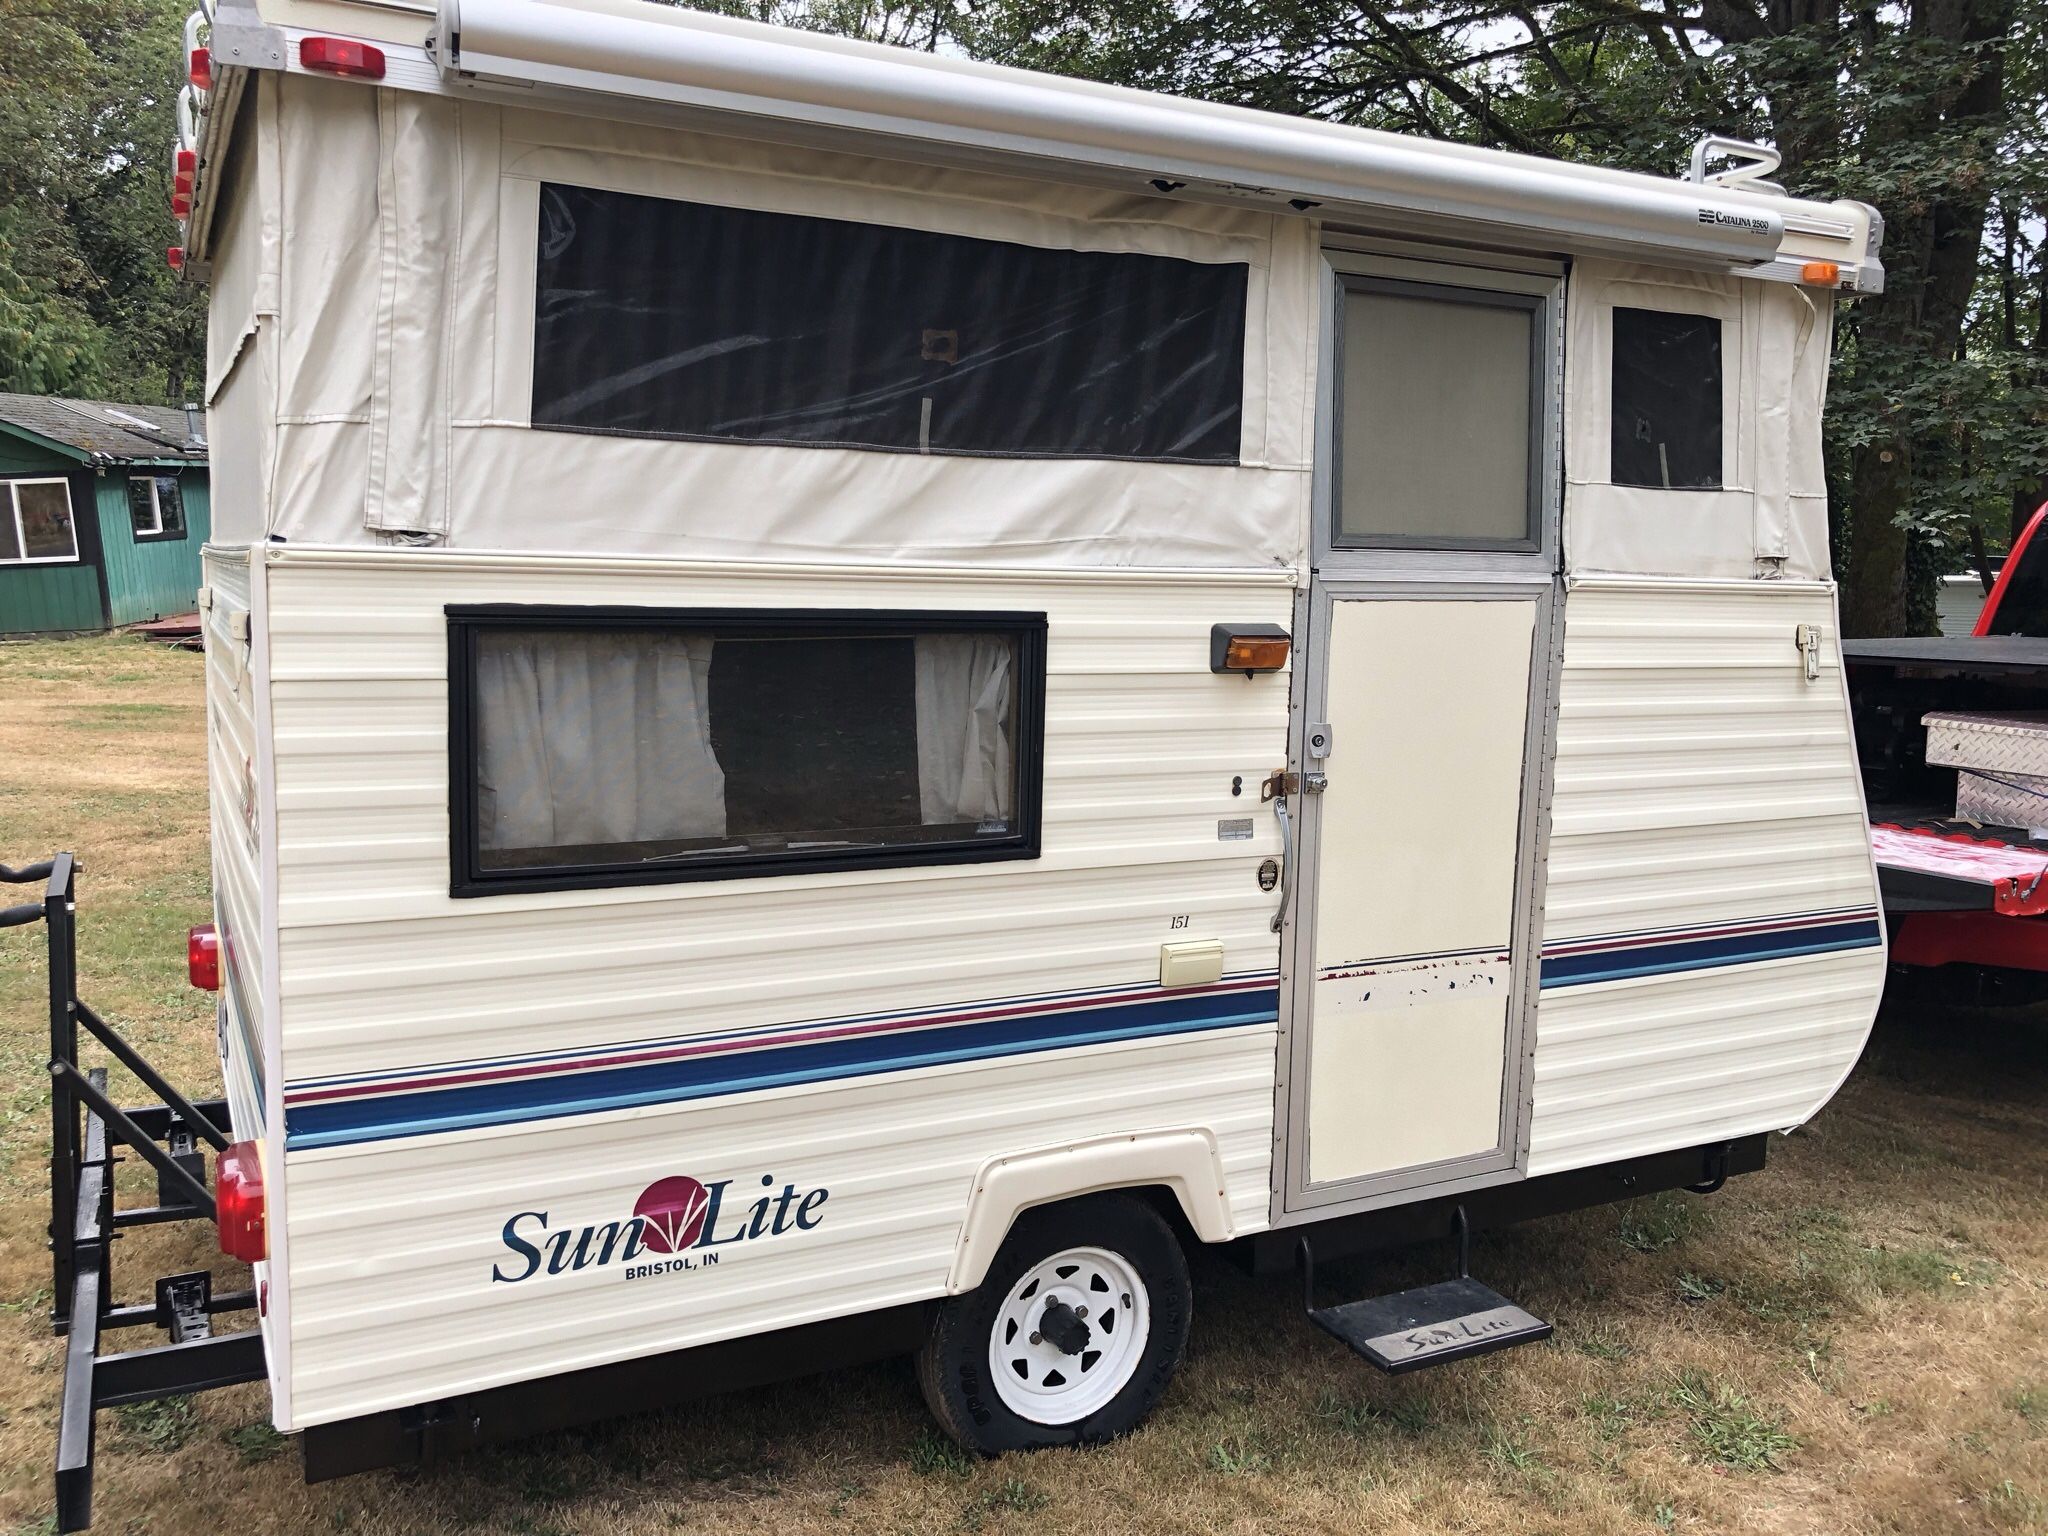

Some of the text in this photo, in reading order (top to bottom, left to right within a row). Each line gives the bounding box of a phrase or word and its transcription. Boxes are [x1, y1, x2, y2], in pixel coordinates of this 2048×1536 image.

[1752, 219, 1769, 230] 2500
[1169, 915, 1190, 929] 151
[492, 1174, 830, 1283] Sun Lite
[625, 1252, 719, 1280] BRISTOL, IN
